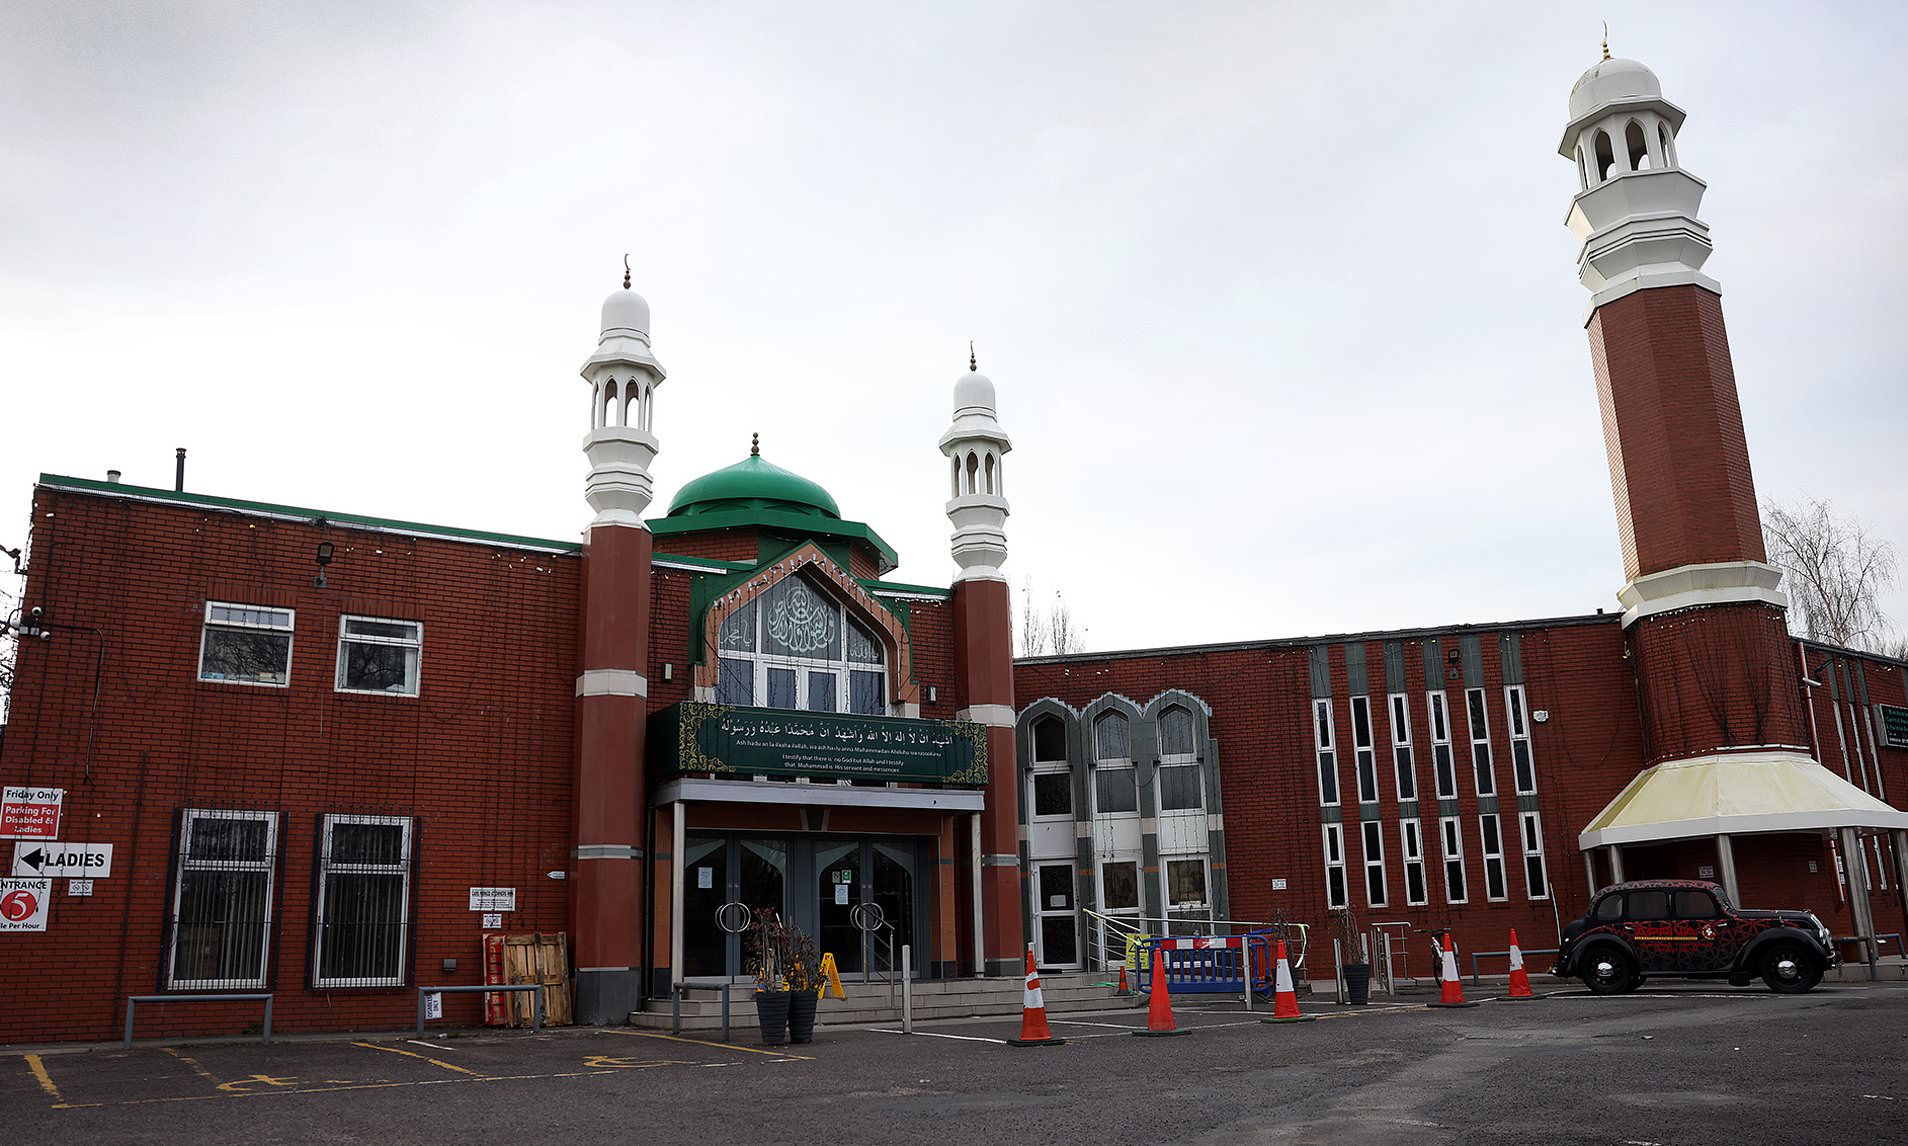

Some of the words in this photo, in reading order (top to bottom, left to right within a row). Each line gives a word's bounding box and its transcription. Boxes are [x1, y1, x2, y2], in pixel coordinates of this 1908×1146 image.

[6, 790, 35, 801] Friday
[37, 792, 59, 801] Only
[5, 807, 39, 816] Parking
[45, 854, 105, 867] LADIES
[0, 881, 47, 889] NTRANCE
[11, 893, 27, 919] 5
